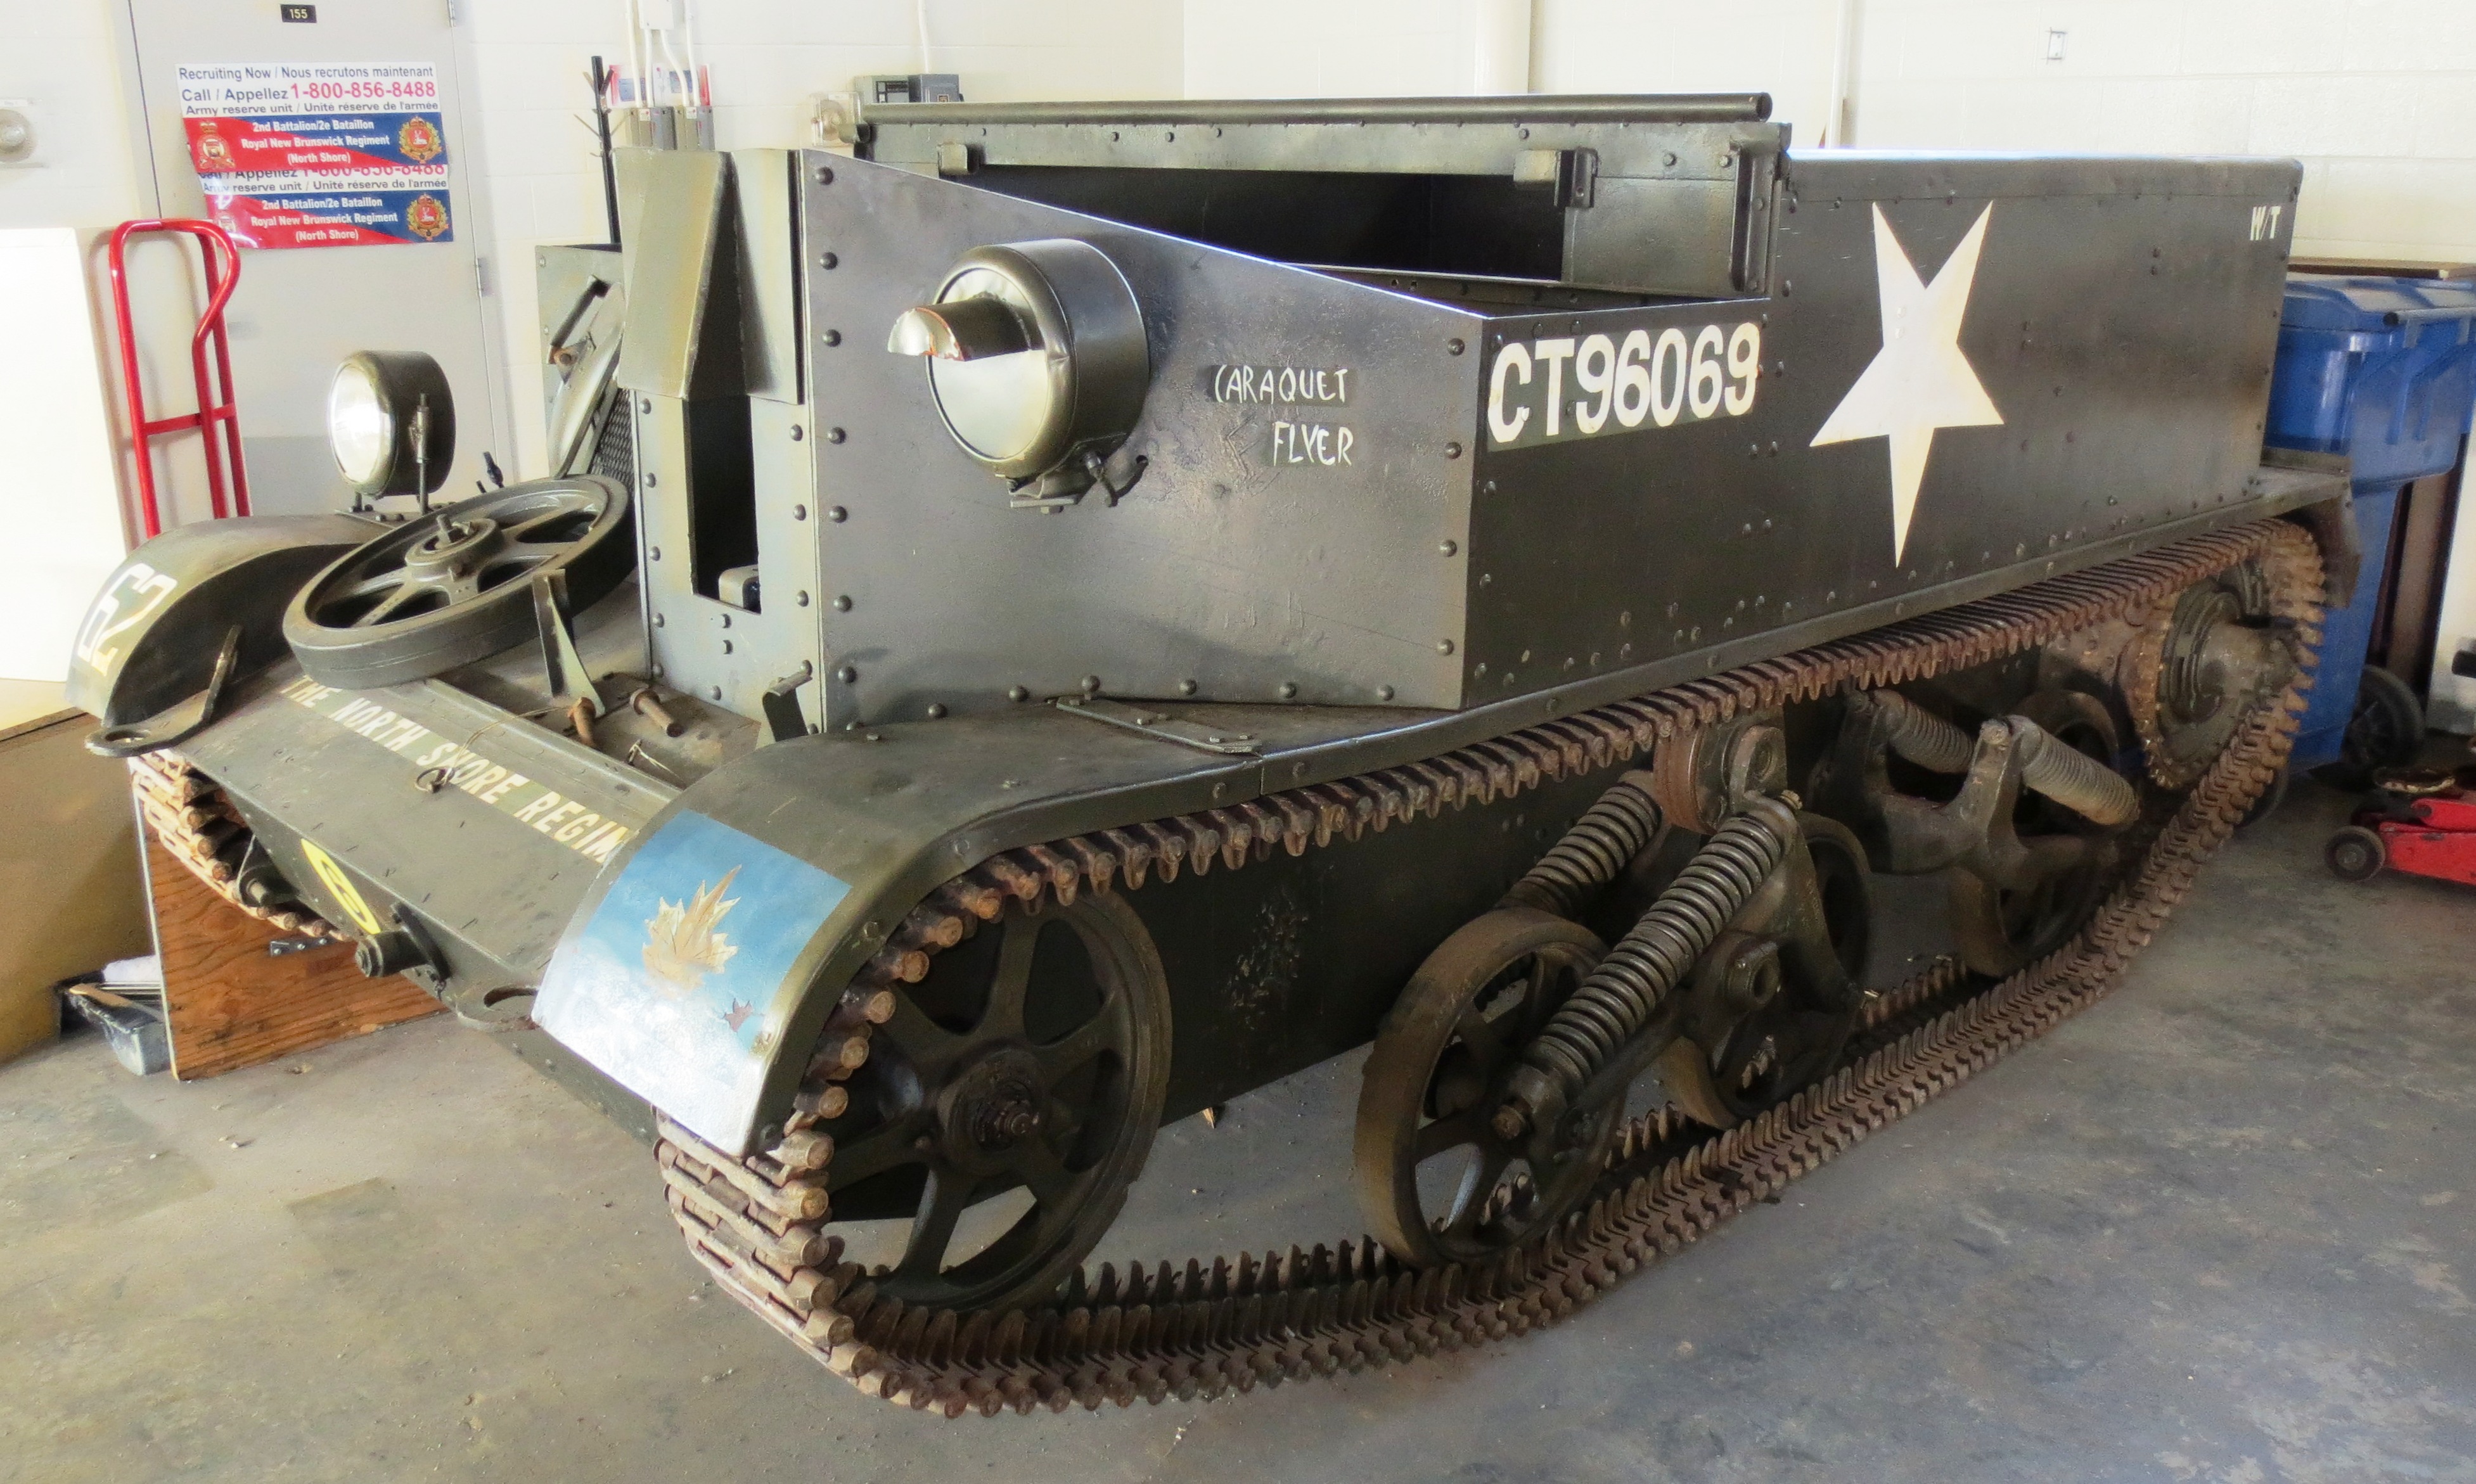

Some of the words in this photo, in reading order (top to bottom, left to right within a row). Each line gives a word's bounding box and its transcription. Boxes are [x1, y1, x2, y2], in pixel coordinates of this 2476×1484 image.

[290, 8, 308, 19] 155
[179, 67, 242, 82] Recruiting
[245, 67, 271, 79] Now
[281, 67, 311, 79] Nous
[315, 67, 369, 78] recrutons
[373, 66, 433, 77] maintenant
[182, 89, 211, 101] Call
[225, 88, 288, 103] Appellez
[290, 81, 435, 99] 1-800-856-8488
[186, 105, 218, 116] Army
[270, 104, 292, 113] unit
[304, 102, 335, 112] Unité
[338, 102, 379, 111] réserve
[383, 102, 396, 110] de
[400, 101, 438, 110] l'armée
[252, 122, 271, 132] 2nd
[273, 120, 330, 132] Battalion/2e
[331, 119, 374, 130] Bataillon
[241, 138, 268, 150] Royal
[269, 138, 292, 148] New
[294, 136, 344, 147] Brunswick
[345, 135, 390, 148] Regiment
[287, 153, 317, 165] (North
[320, 151, 351, 163] Shore)
[235, 170, 298, 181] Appellez
[279, 182, 302, 191] unit
[313, 180, 343, 189] Unité
[348, 179, 388, 189] réserve
[392, 179, 405, 188] de
[409, 178, 447, 188] l'armée
[262, 200, 279, 210] 2nd
[282, 198, 339, 209] Battalion/2e
[341, 196, 383, 208] Bataillon
[250, 215, 276, 228] Royal
[278, 215, 300, 225] New
[303, 214, 352, 224] Brunswick
[354, 212, 398, 225] Regiment
[295, 231, 326, 243] (North
[329, 229, 359, 241] Shore)
[1214, 364, 1349, 404] CARAQUET
[1487, 322, 1761, 443] CT96069
[1273, 421, 1354, 466] FLYER
[77, 562, 178, 677] 62
[279, 674, 343, 708] THE
[328, 697, 431, 752] NORTH
[416, 742, 530, 805] SHORE
